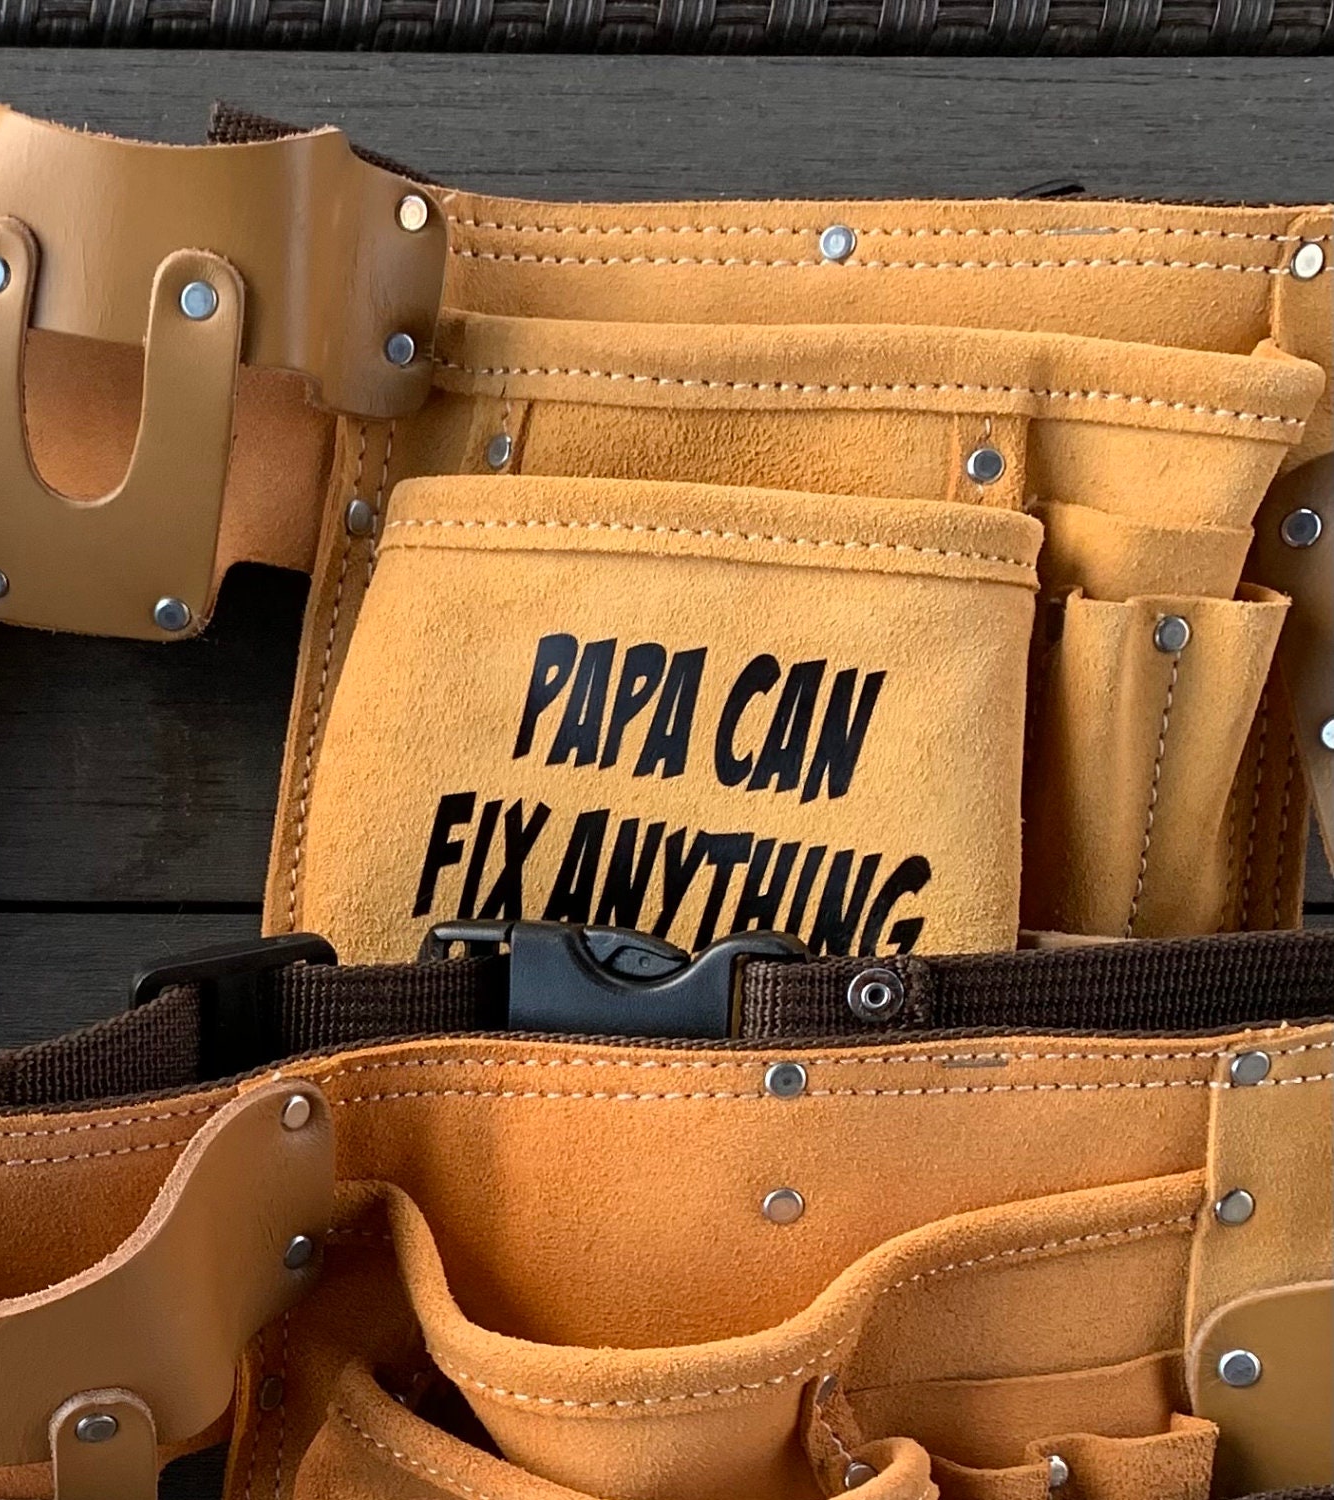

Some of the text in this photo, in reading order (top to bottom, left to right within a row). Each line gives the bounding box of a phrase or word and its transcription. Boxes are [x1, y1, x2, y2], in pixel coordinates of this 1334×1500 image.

[513, 634, 886, 803] PAPA CAN
[412, 792, 932, 957] FIX ANYTHING
